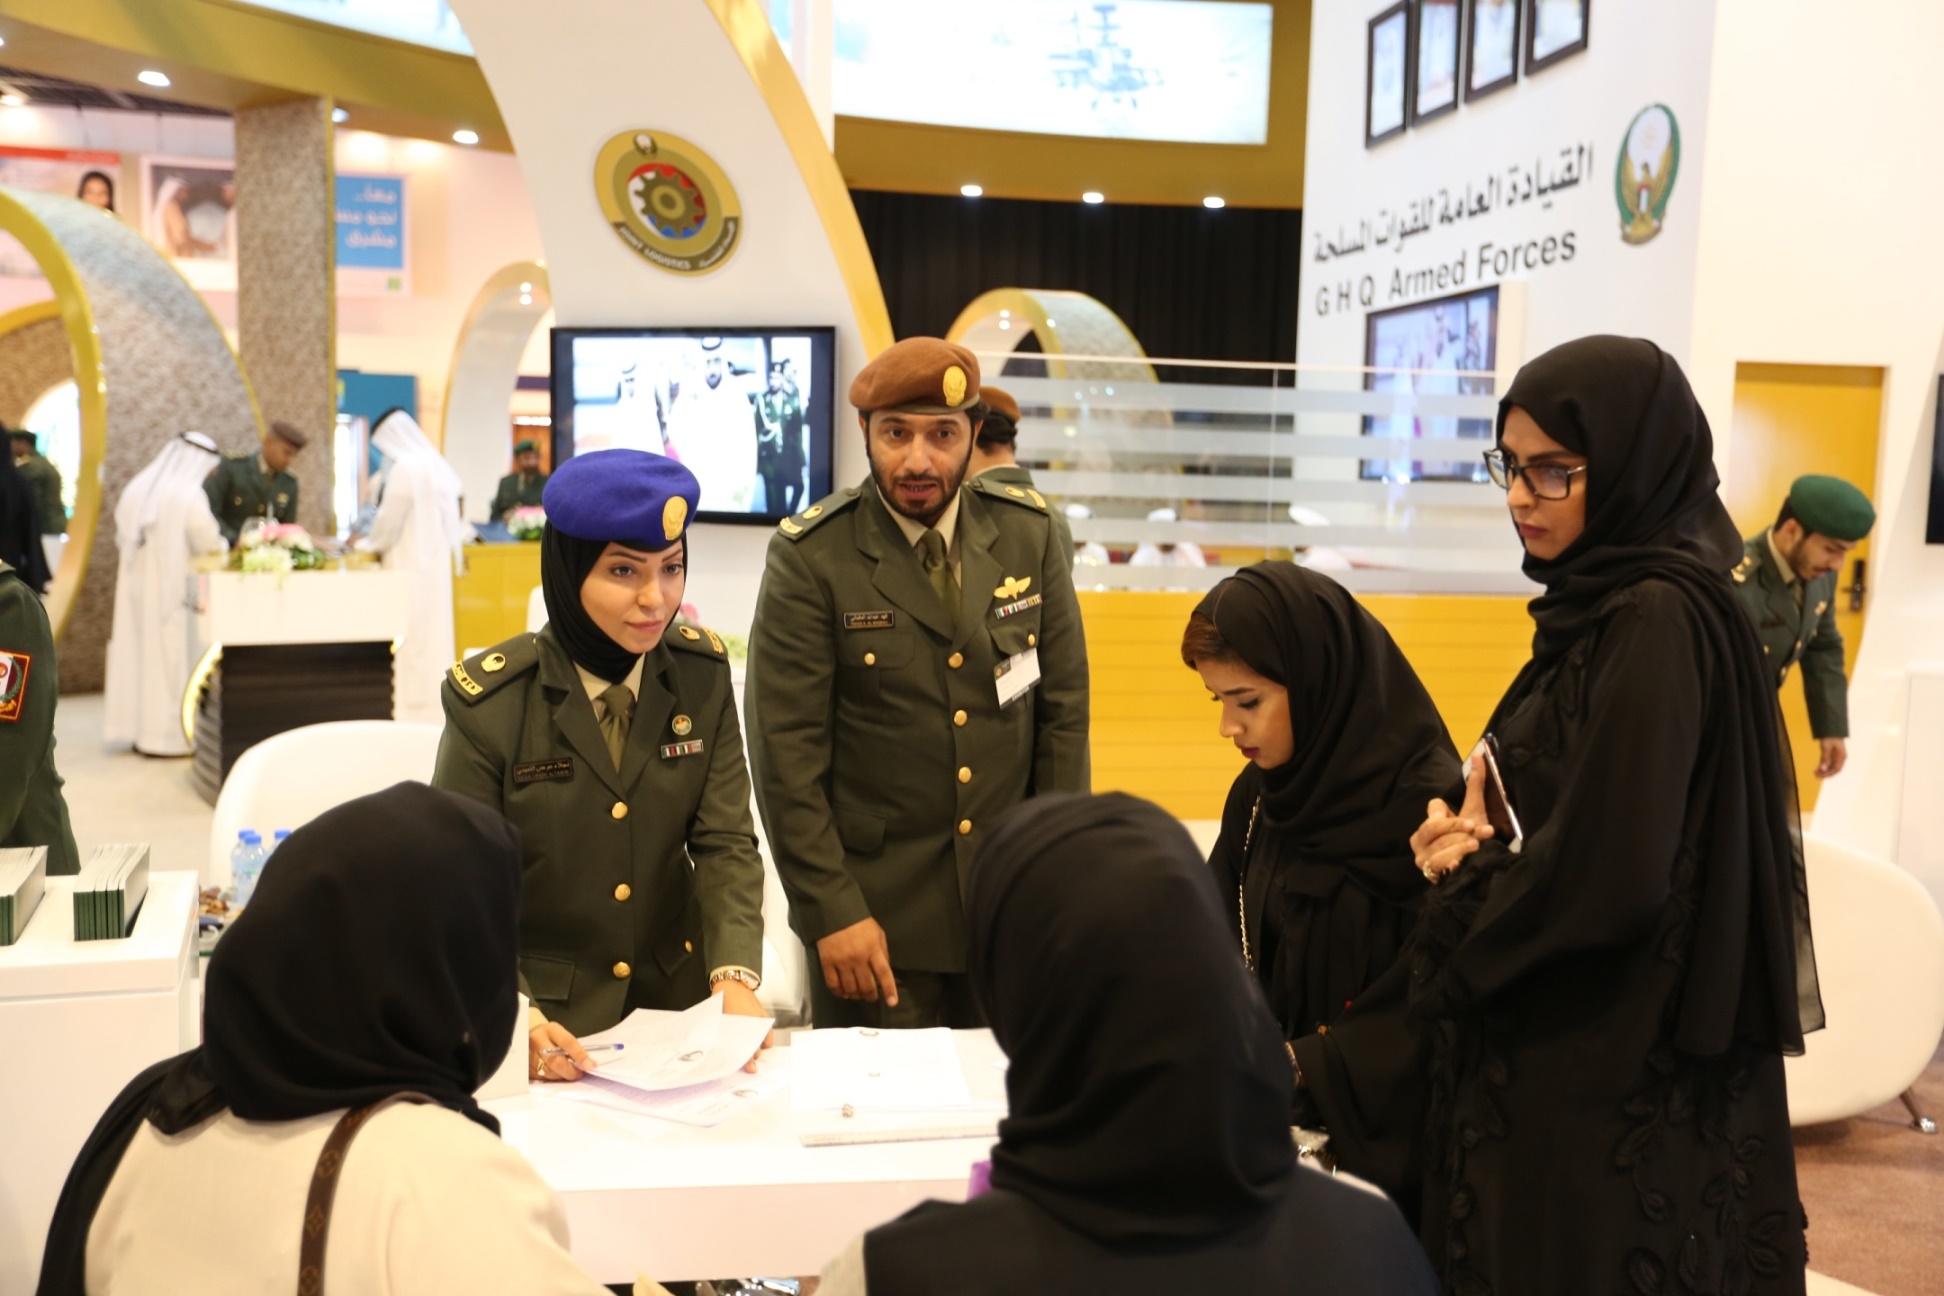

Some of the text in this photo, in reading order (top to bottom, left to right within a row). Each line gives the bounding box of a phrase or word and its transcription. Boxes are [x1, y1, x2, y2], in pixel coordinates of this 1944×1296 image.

[1314, 140, 1594, 262] القيادة العامة للقوات المسلحة
[1388, 250, 1468, 302] Armed
[1478, 229, 1577, 280] Forces
